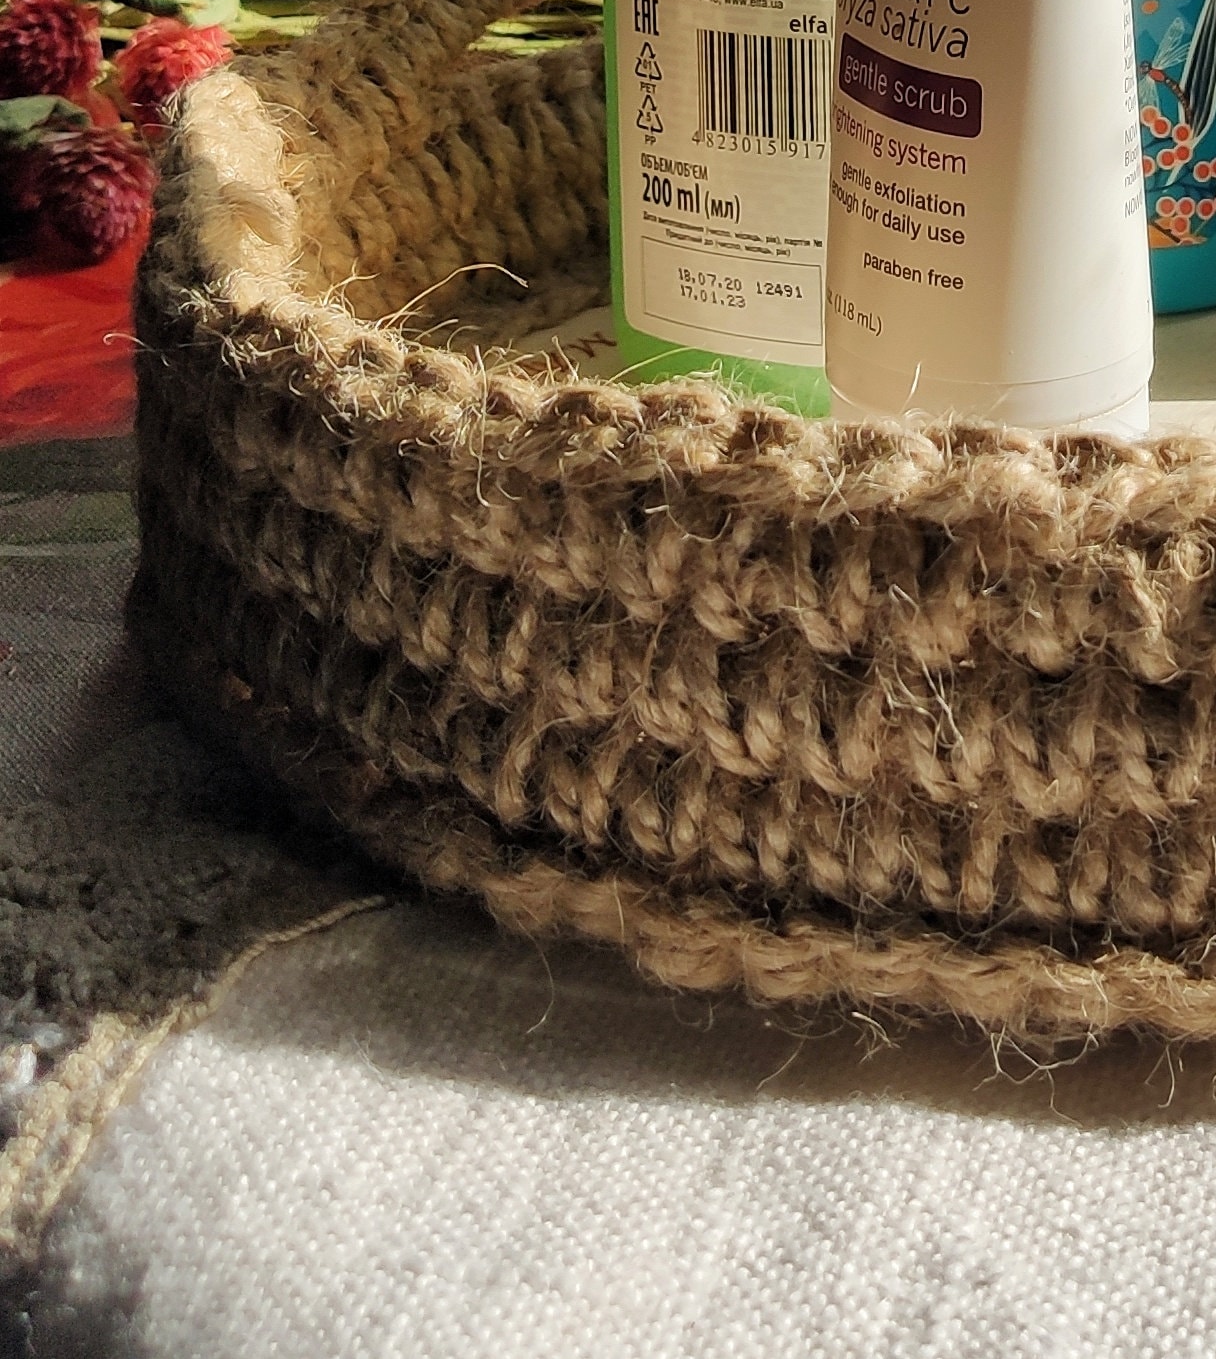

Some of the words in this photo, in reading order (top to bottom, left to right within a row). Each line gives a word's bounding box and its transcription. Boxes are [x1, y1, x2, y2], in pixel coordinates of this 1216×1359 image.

[788, 14, 828, 34] elfa
[880, 3, 969, 59] sativa
[640, 81, 656, 95] PET
[843, 52, 887, 96] gentle
[893, 80, 967, 119] scrub
[887, 137, 966, 175] system
[642, 172, 672, 208] 200
[677, 182, 700, 214] ml
[704, 190, 740, 224] (мл)
[842, 160, 871, 190] gentle
[874, 179, 966, 218] exfoliation
[861, 198, 879, 223] for
[881, 209, 922, 241] daily
[927, 222, 966, 246] use
[756, 281, 803, 299] 12491
[863, 251, 922, 284] paraben
[927, 269, 964, 291] free
[680, 283, 746, 308] 17.01.23
[857, 311, 882, 337] mL)
